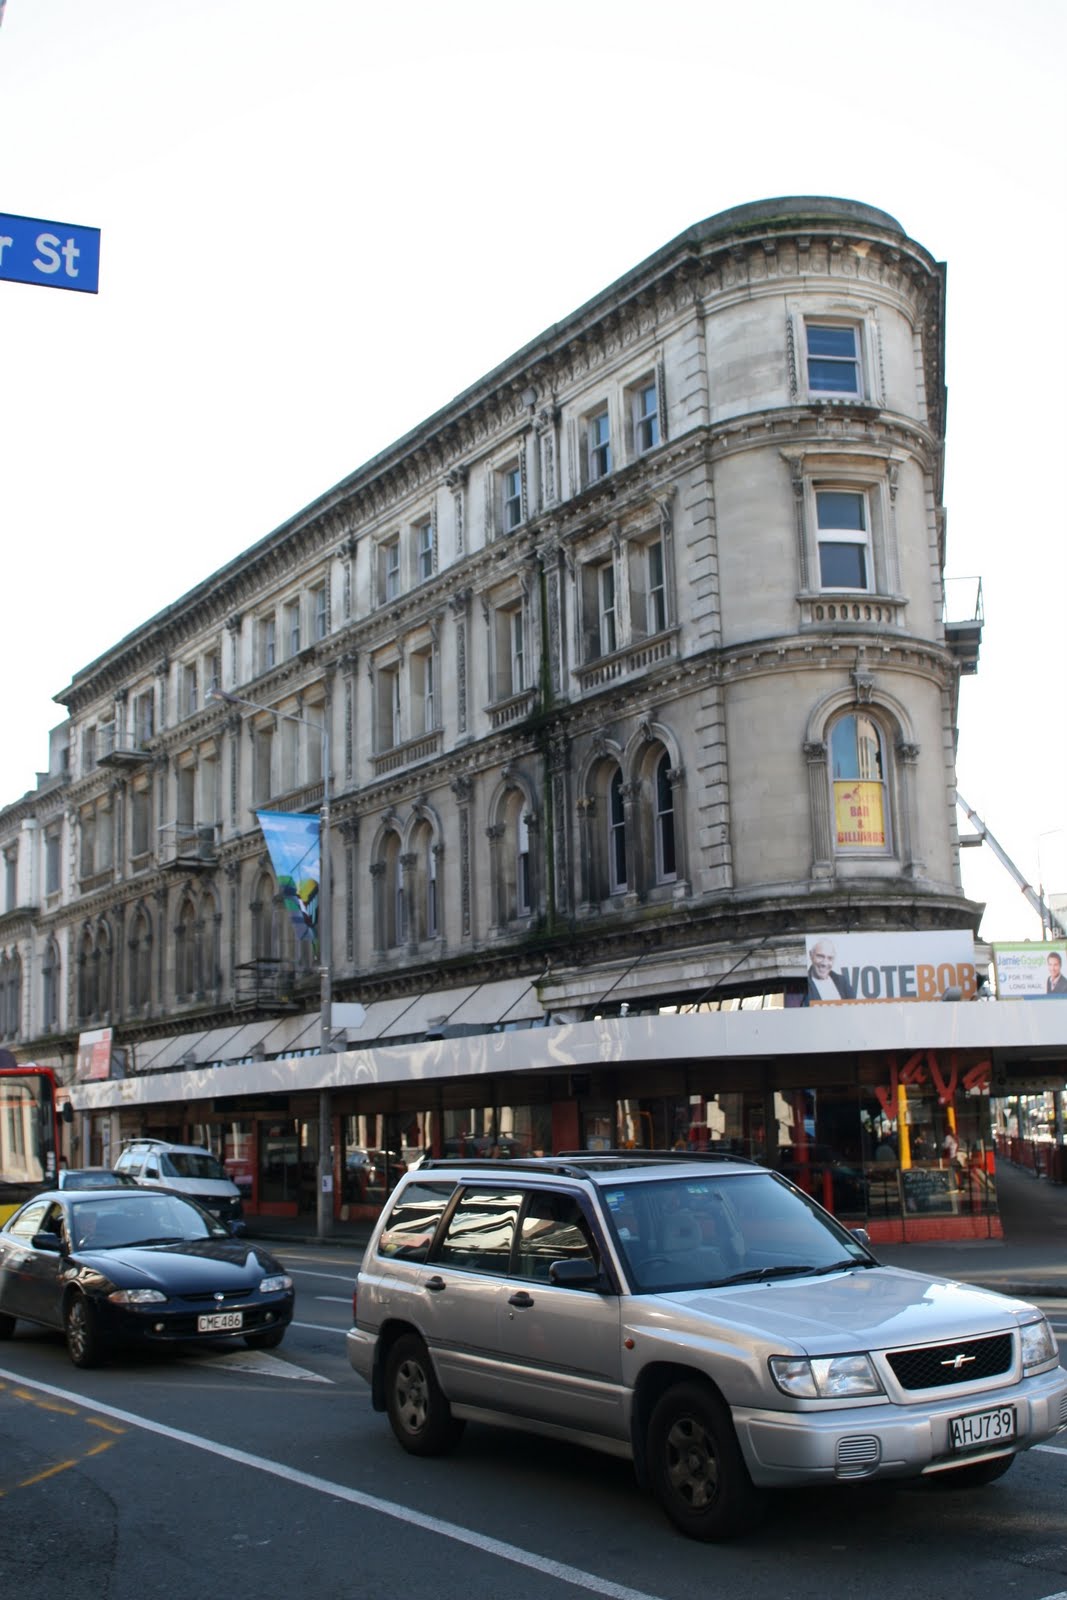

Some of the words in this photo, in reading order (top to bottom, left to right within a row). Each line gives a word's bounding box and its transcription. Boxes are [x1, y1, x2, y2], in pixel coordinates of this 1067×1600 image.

[32, 233, 80, 278] St
[837, 831, 884, 843] BILLIARDS
[199, 1315, 240, 1330] CME486
[953, 1411, 1012, 1444] AHJ739
